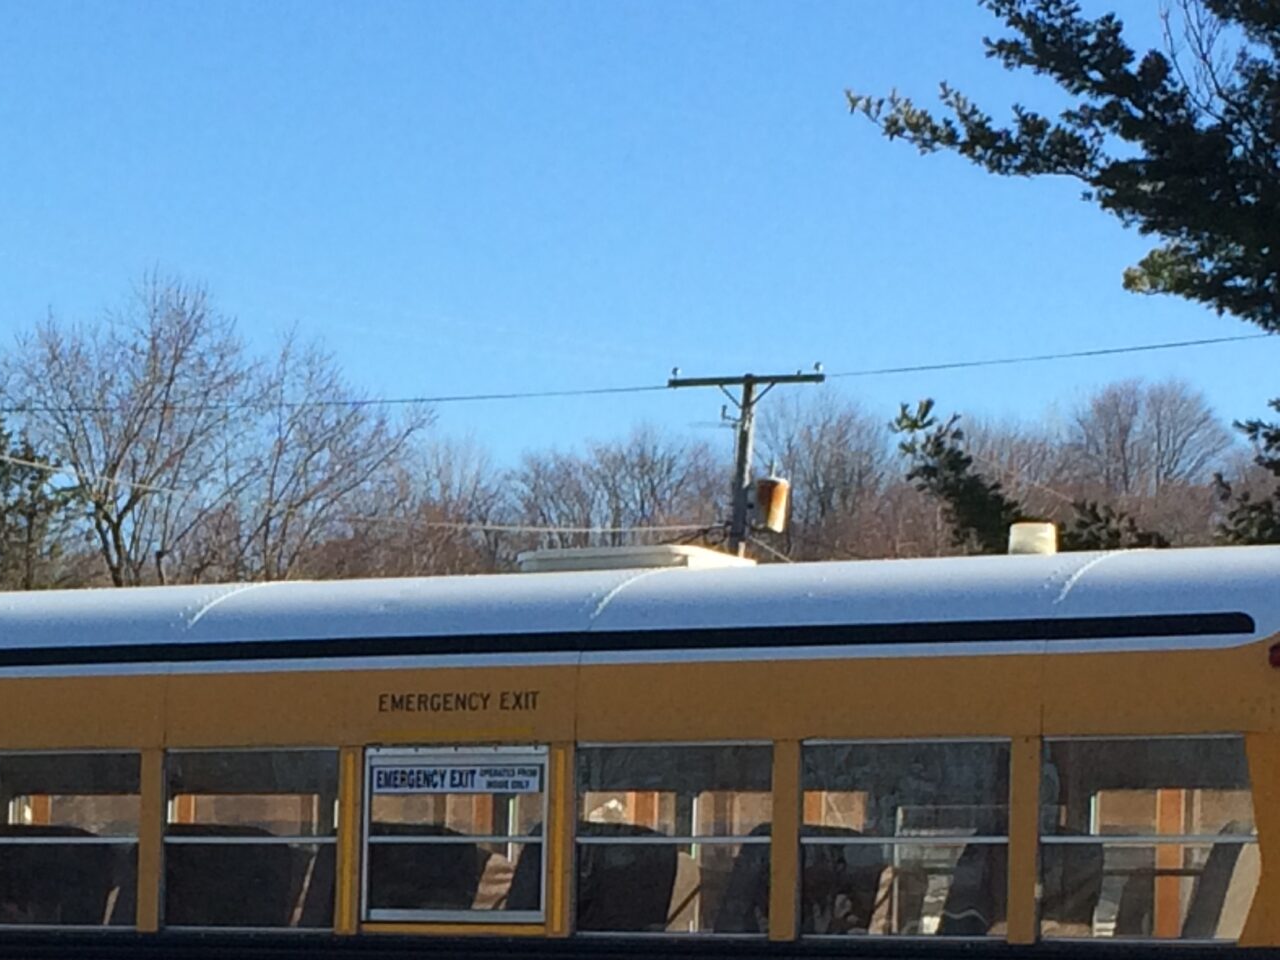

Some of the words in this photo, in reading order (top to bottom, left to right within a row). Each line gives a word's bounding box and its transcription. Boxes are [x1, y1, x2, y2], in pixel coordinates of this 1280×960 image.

[378, 693, 491, 712] EMERGENCY
[499, 691, 540, 711] EXIT
[376, 769, 446, 789] EMERGENCY
[449, 769, 477, 788] EXIT
